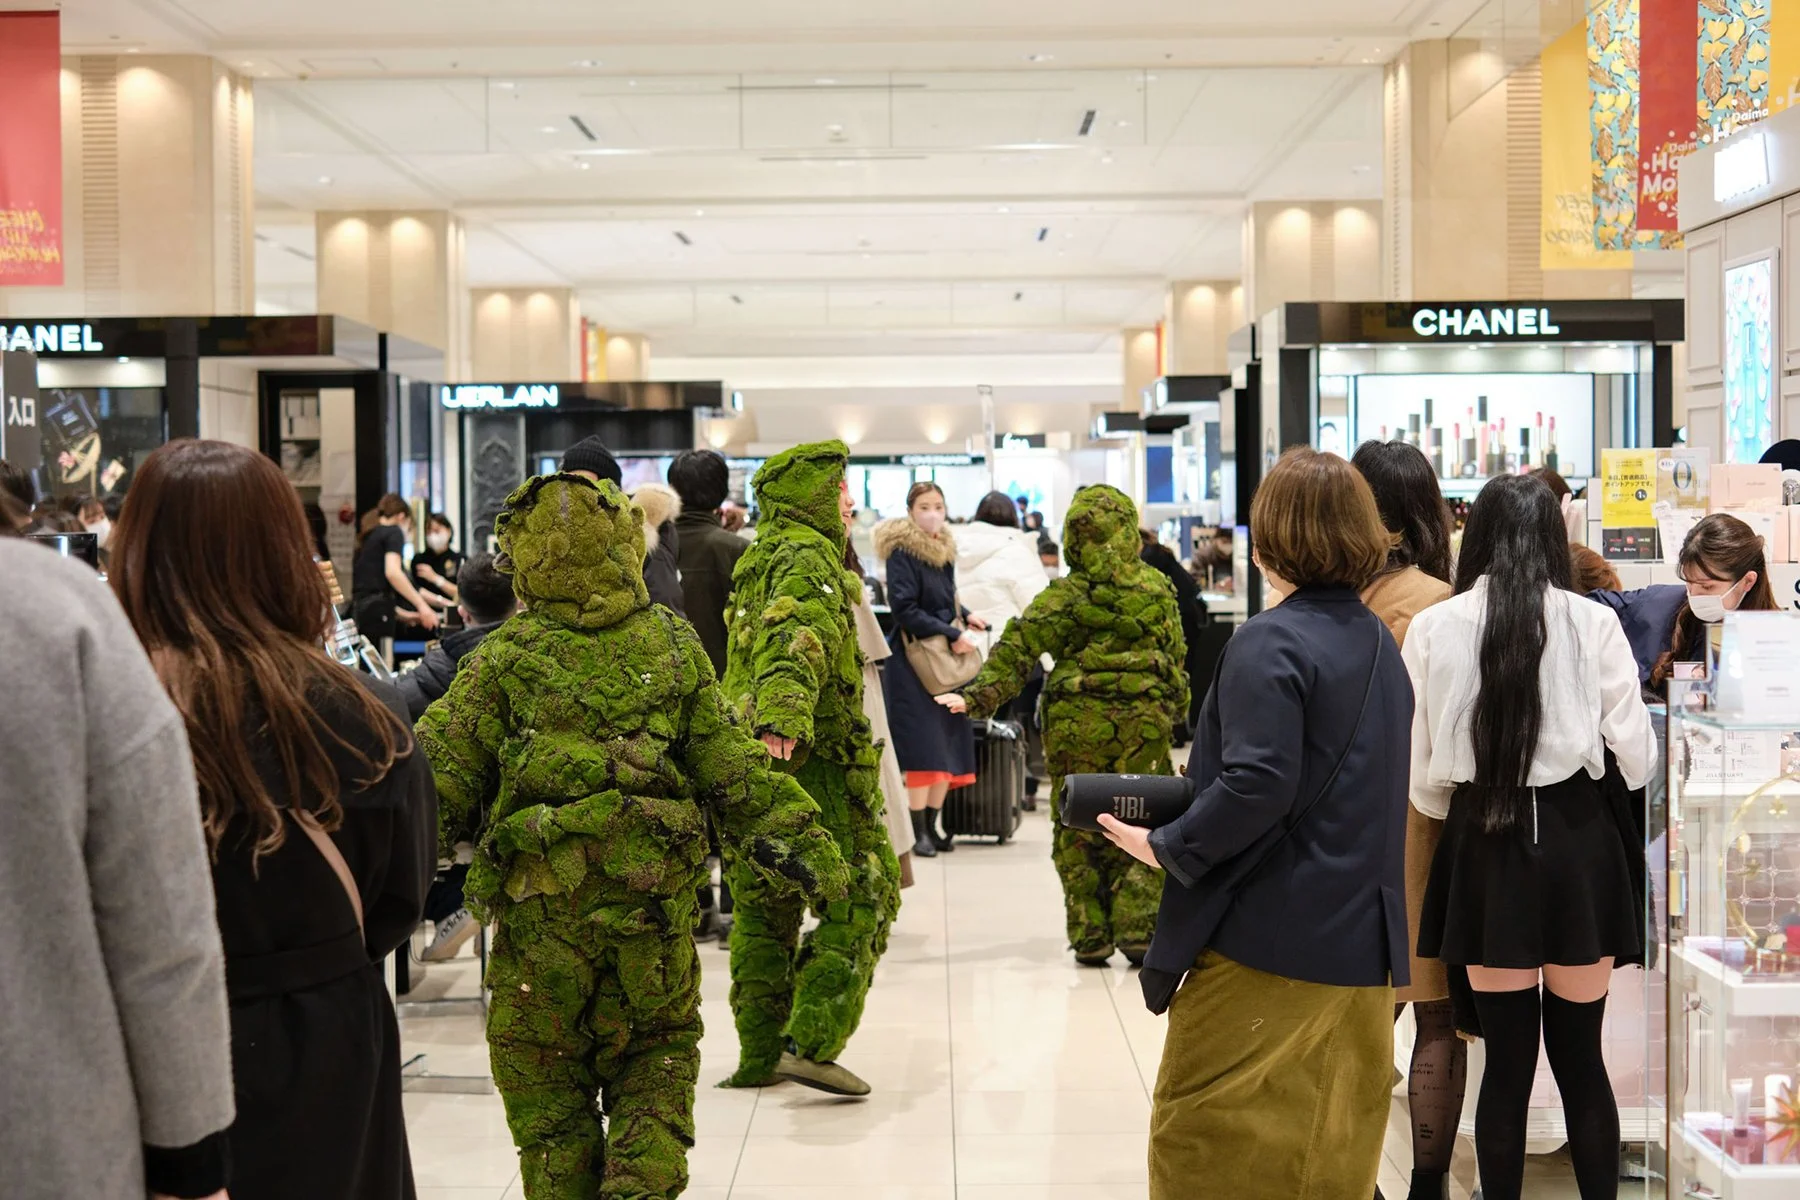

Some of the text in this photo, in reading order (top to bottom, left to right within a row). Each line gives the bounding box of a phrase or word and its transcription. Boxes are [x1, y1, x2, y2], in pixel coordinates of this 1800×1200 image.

[1412, 308, 1560, 336] CHANEL
[8, 396, 36, 428] 入口
[1113, 796, 1150, 820] JBL
